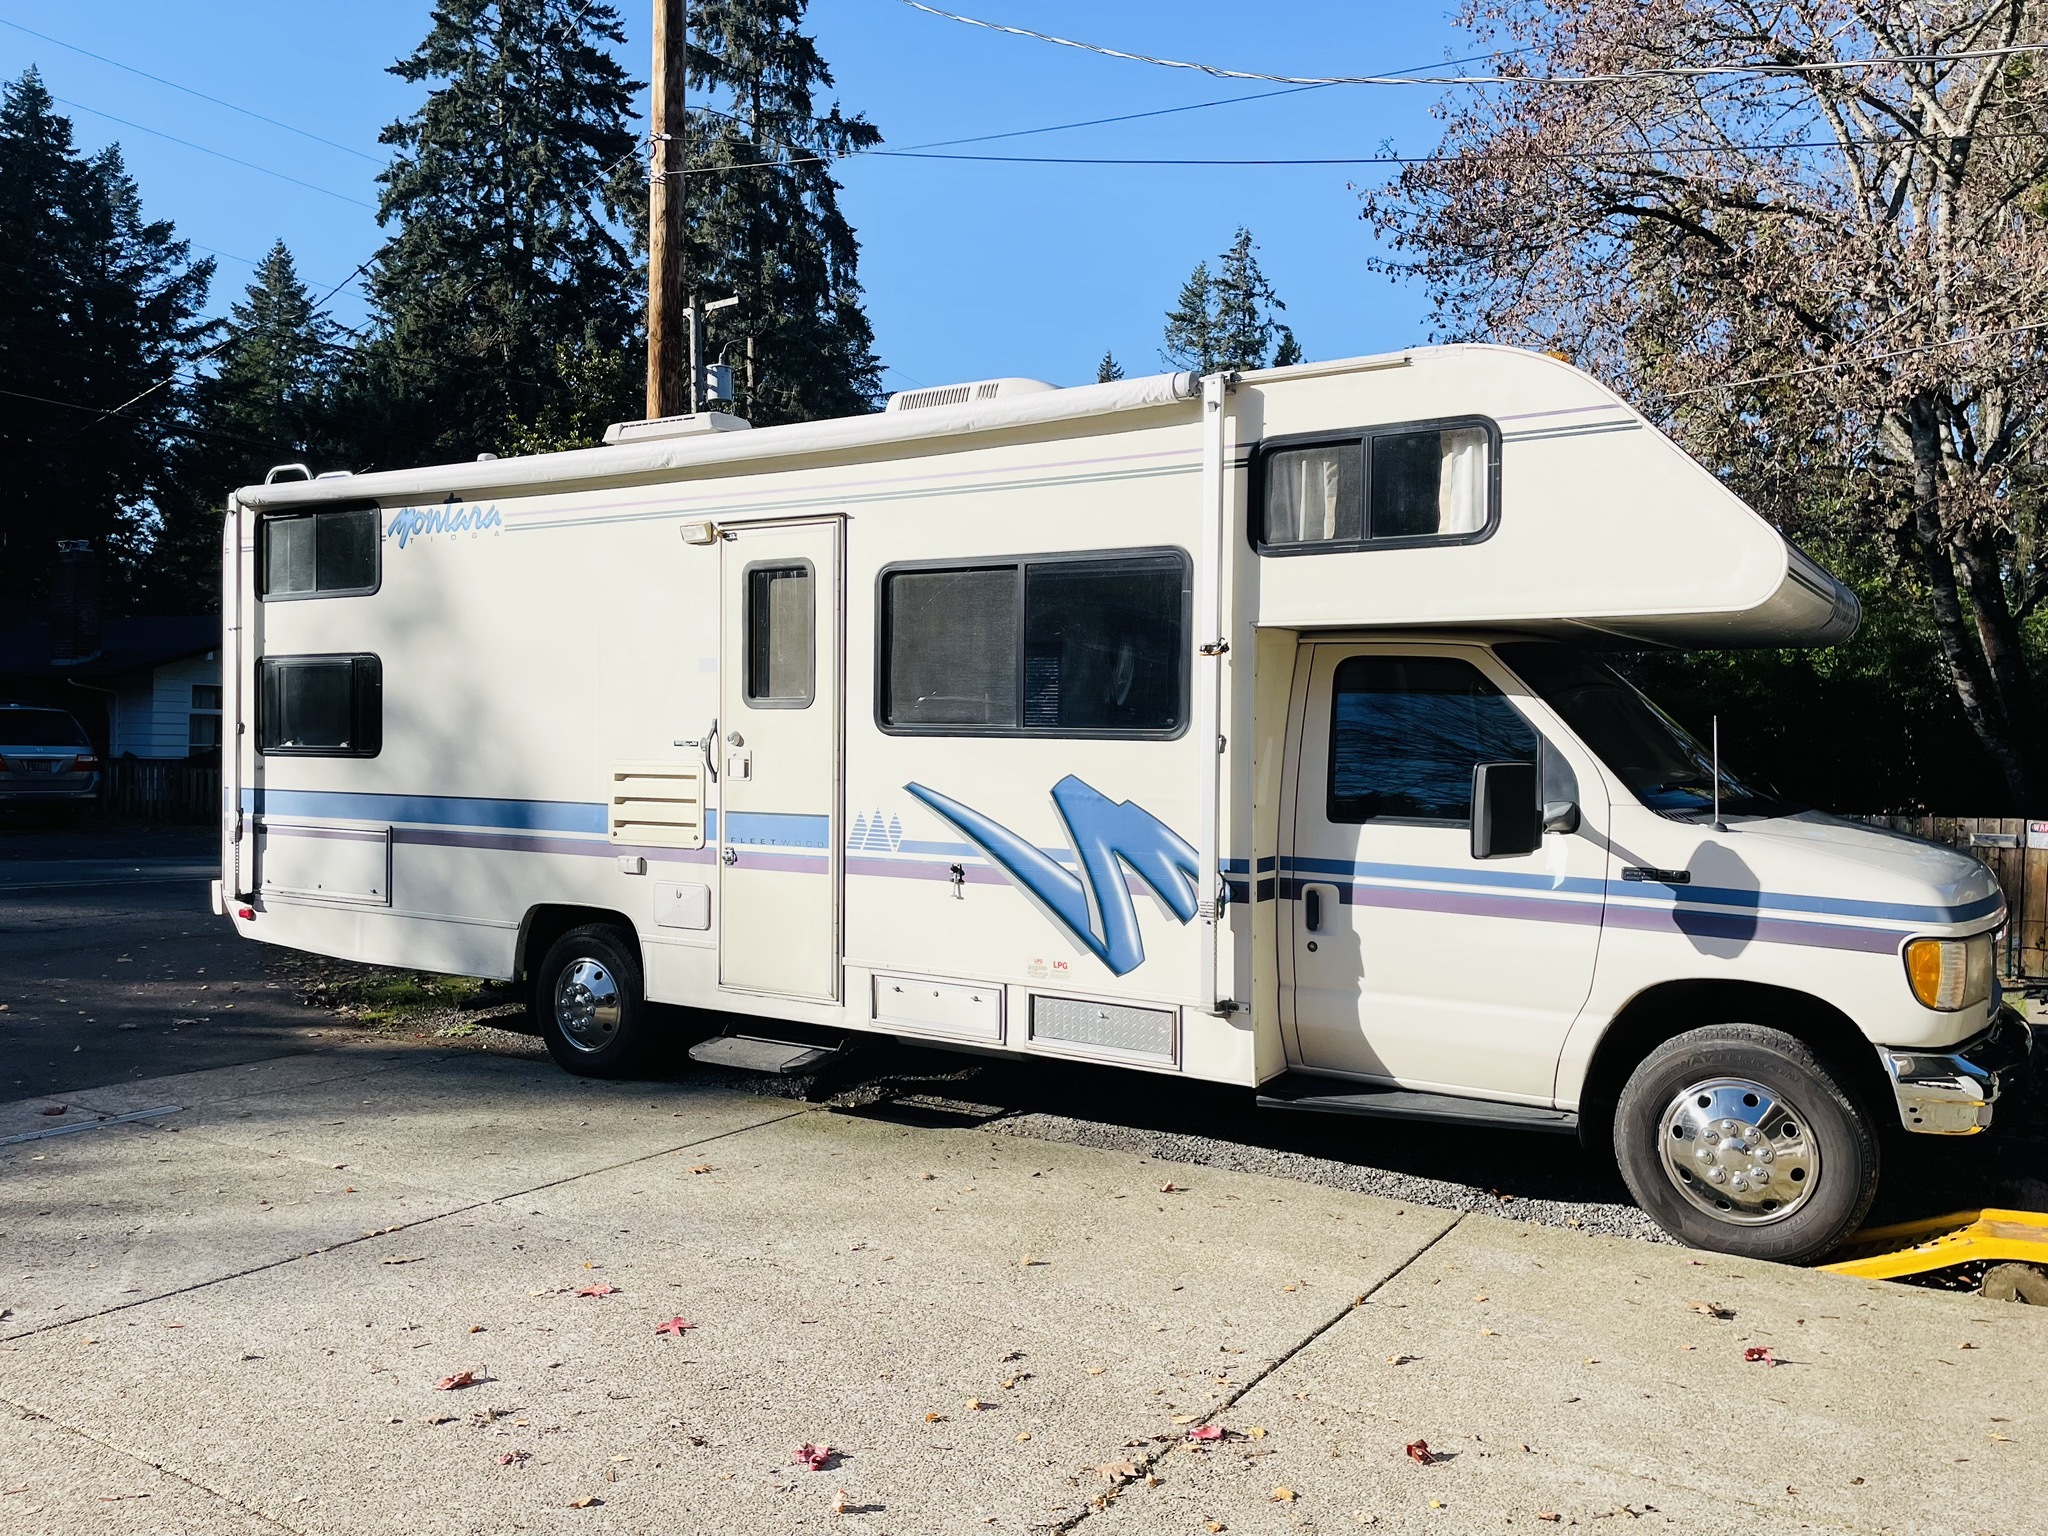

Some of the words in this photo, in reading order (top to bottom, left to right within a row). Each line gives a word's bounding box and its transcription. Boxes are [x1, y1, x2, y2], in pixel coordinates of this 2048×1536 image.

[409, 530, 500, 544] TIOGA
[730, 836, 825, 849] FLEETWOOD
[1053, 960, 1068, 970] LPG
